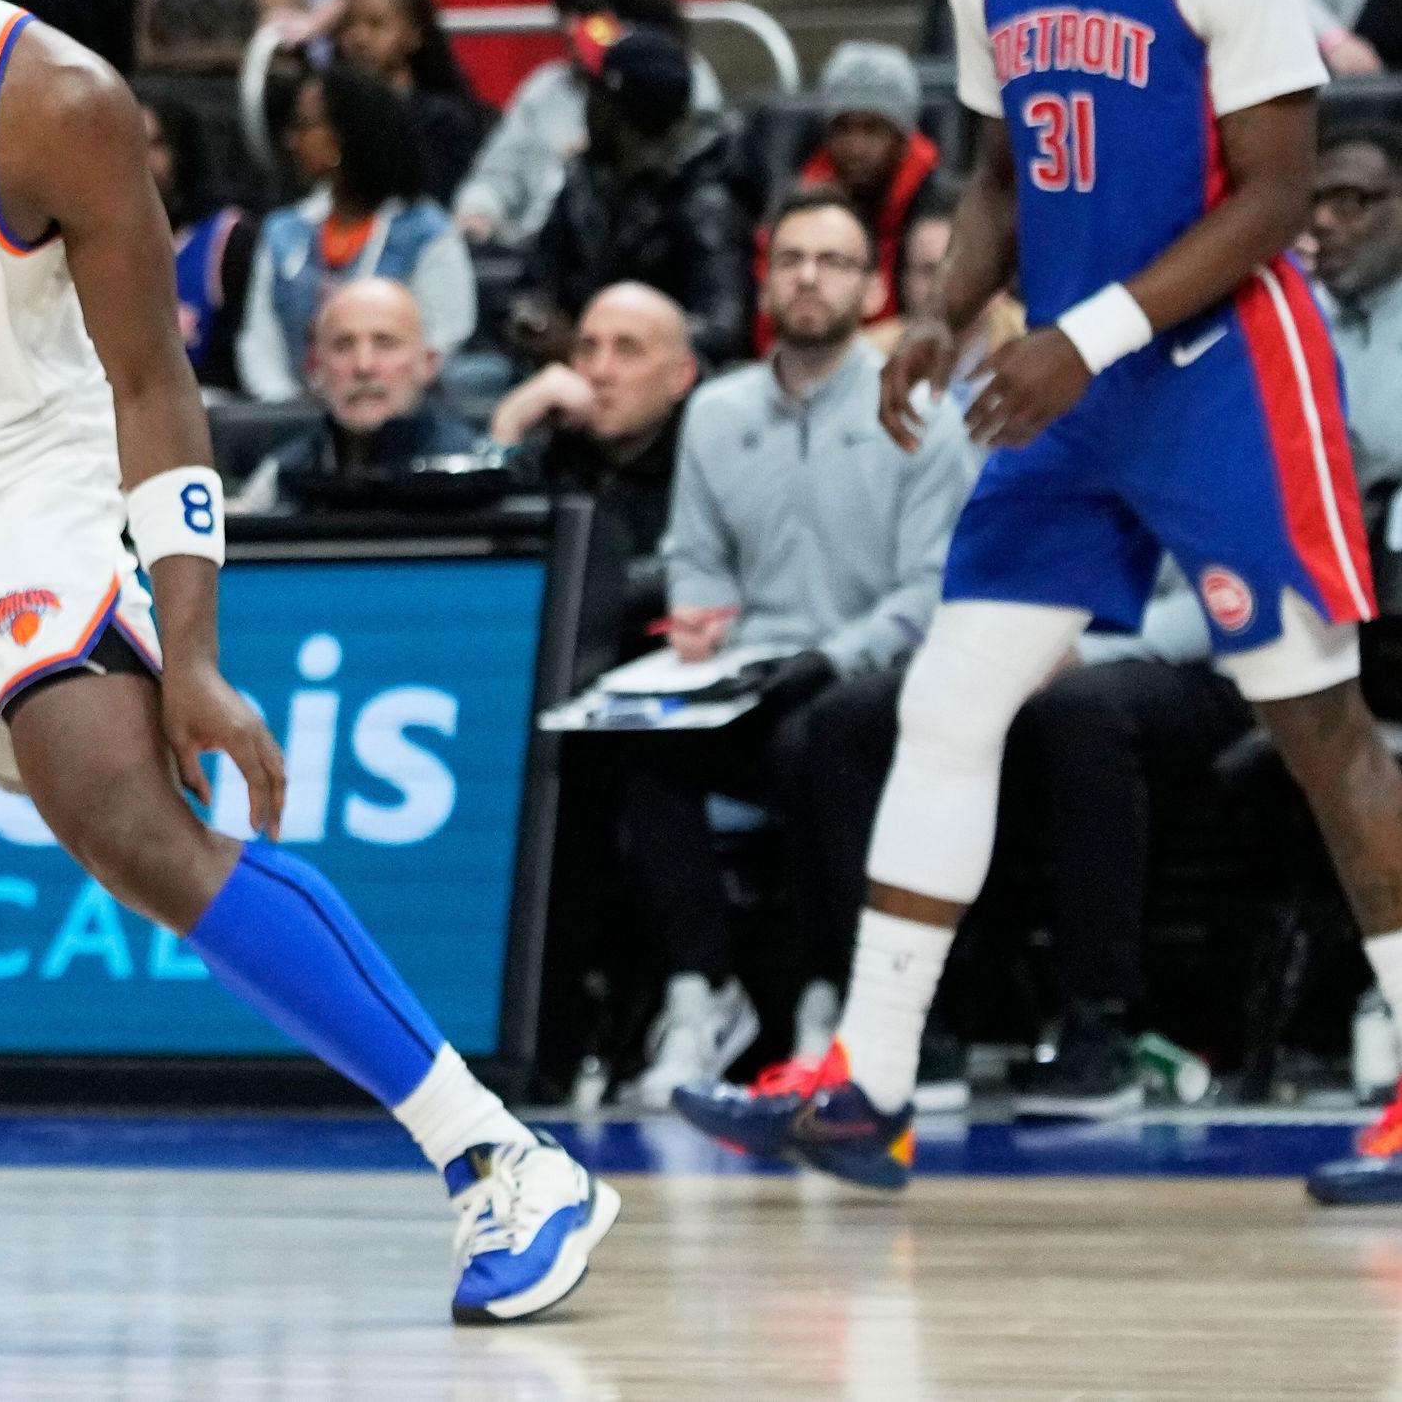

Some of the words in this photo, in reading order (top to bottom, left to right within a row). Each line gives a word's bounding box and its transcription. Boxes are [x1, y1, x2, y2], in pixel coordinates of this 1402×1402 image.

[991, 5, 1156, 89] DETROIT
[1023, 92, 1095, 190] 31
[178, 481, 216, 536] 8
